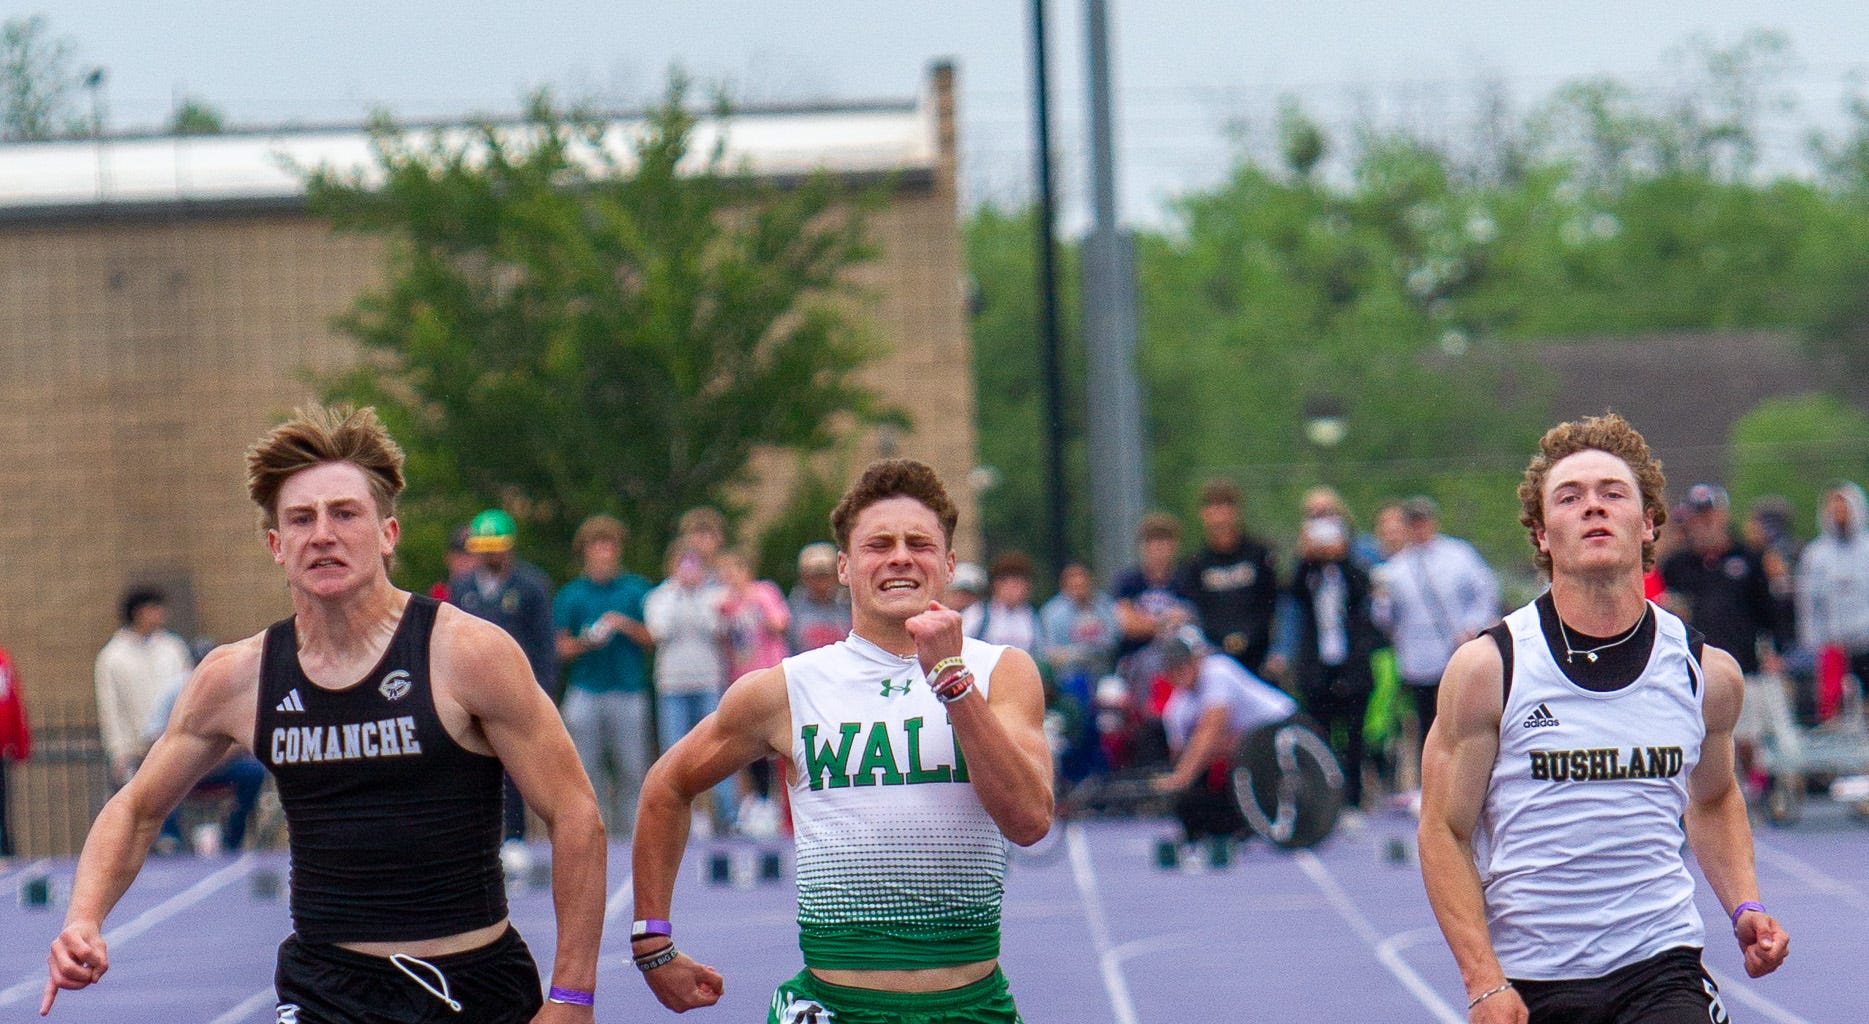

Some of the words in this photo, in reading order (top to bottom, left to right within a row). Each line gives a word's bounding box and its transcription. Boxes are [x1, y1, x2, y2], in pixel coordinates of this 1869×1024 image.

[271, 715, 422, 765] COMANCHE
[1523, 717, 1560, 728] adidas
[1529, 746, 1684, 781] BUSHLAND
